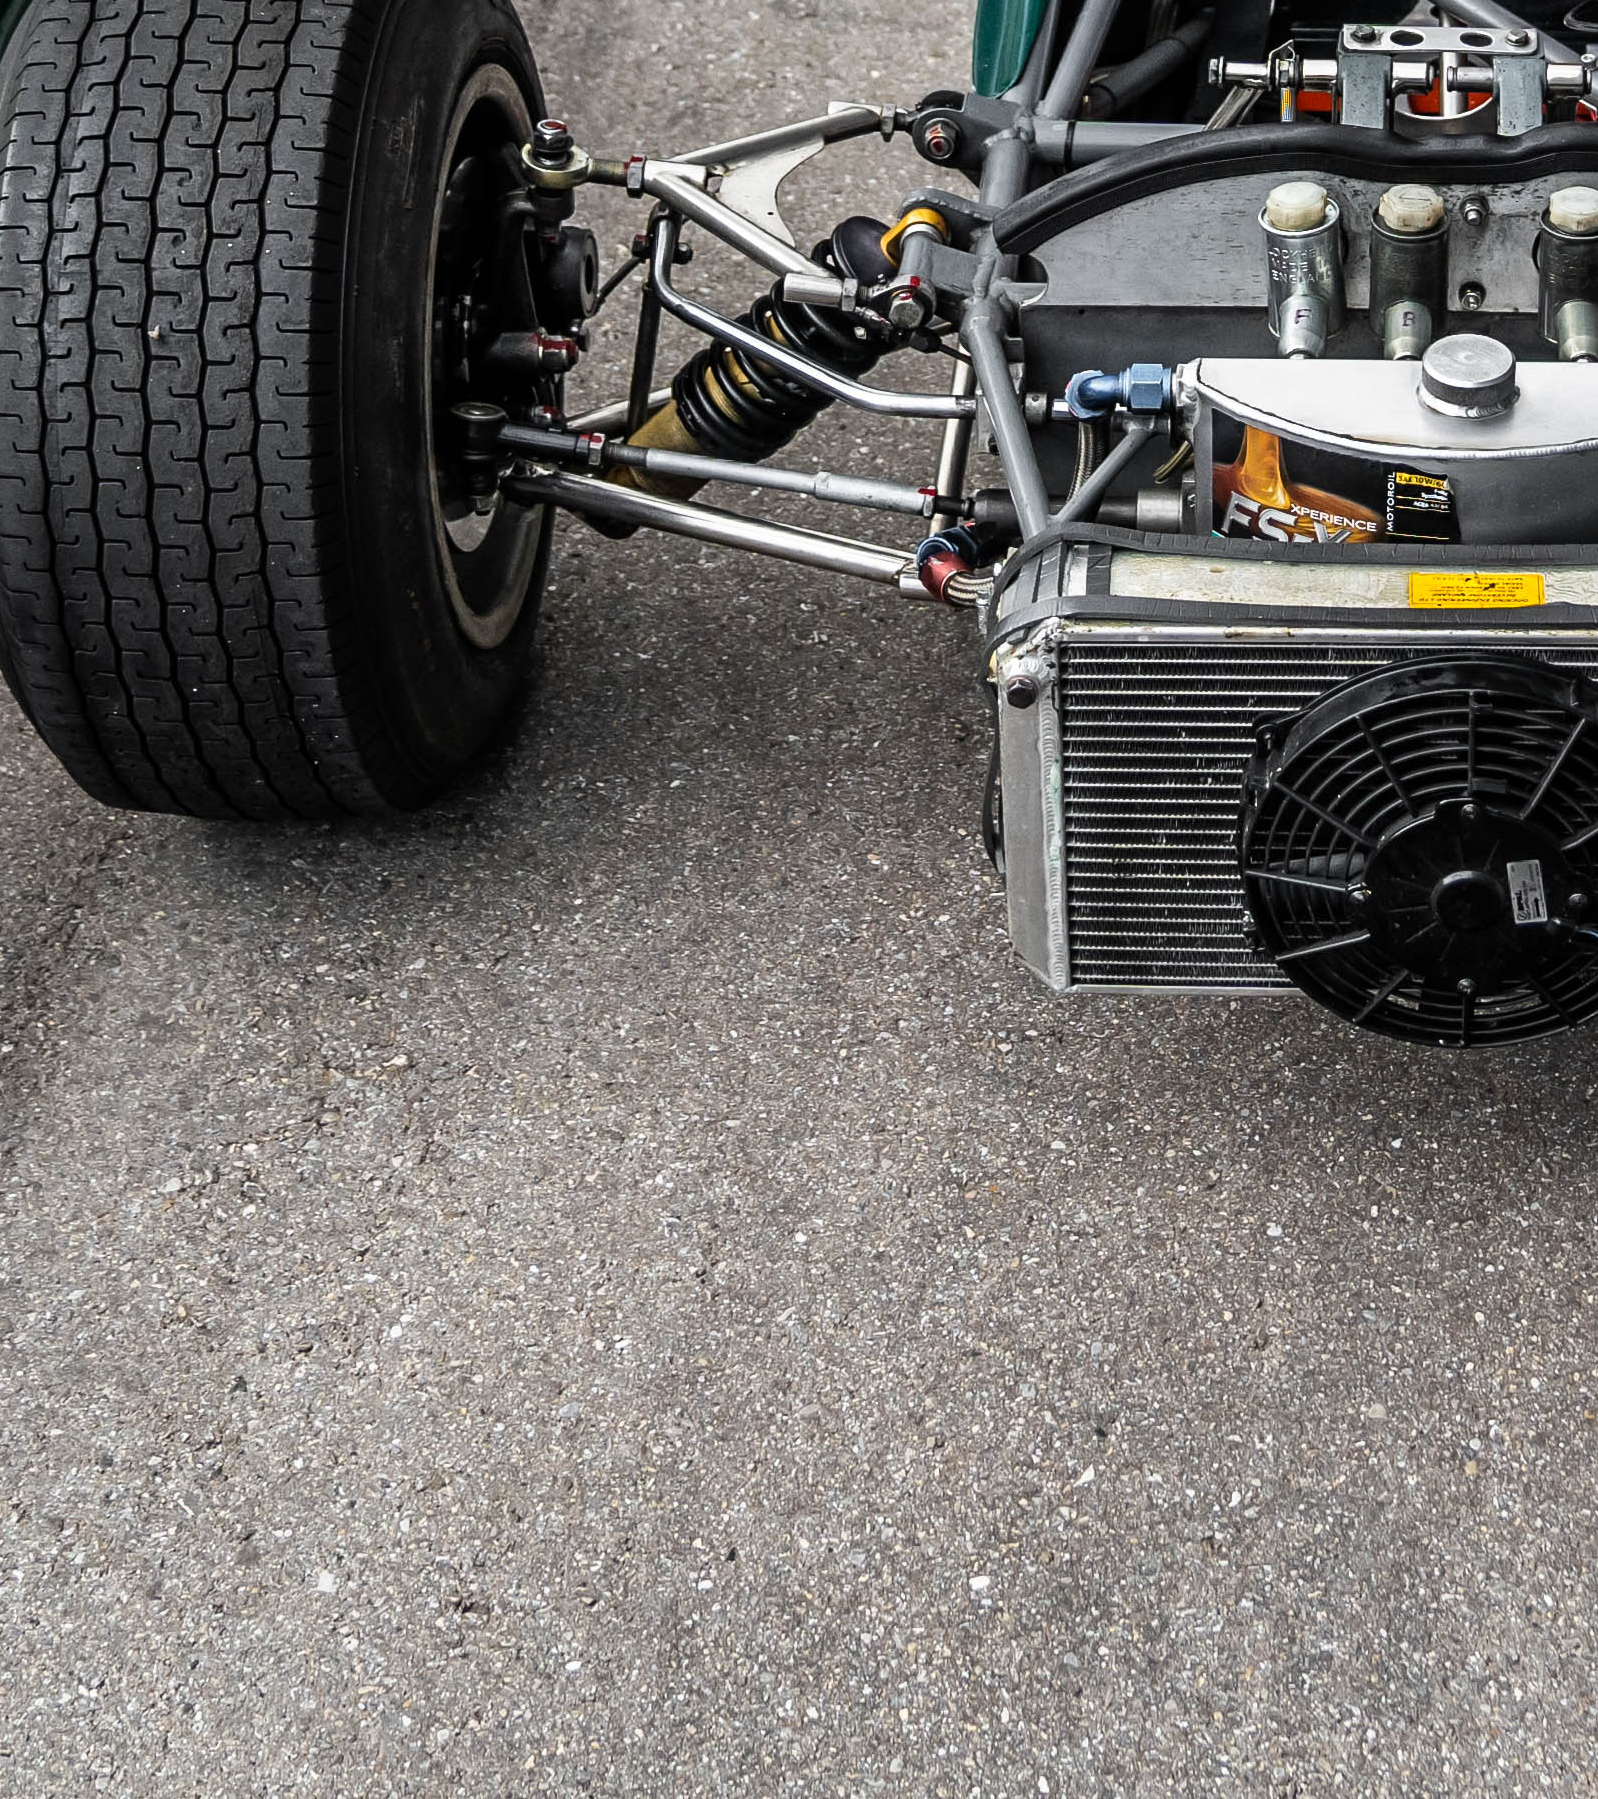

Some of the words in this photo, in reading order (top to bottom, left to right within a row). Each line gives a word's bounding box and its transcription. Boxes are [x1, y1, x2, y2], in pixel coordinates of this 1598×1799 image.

[1294, 308, 1312, 325] F
[1386, 471, 1395, 532] MOTOROIL
[1290, 503, 1378, 532] XPERIENCE
